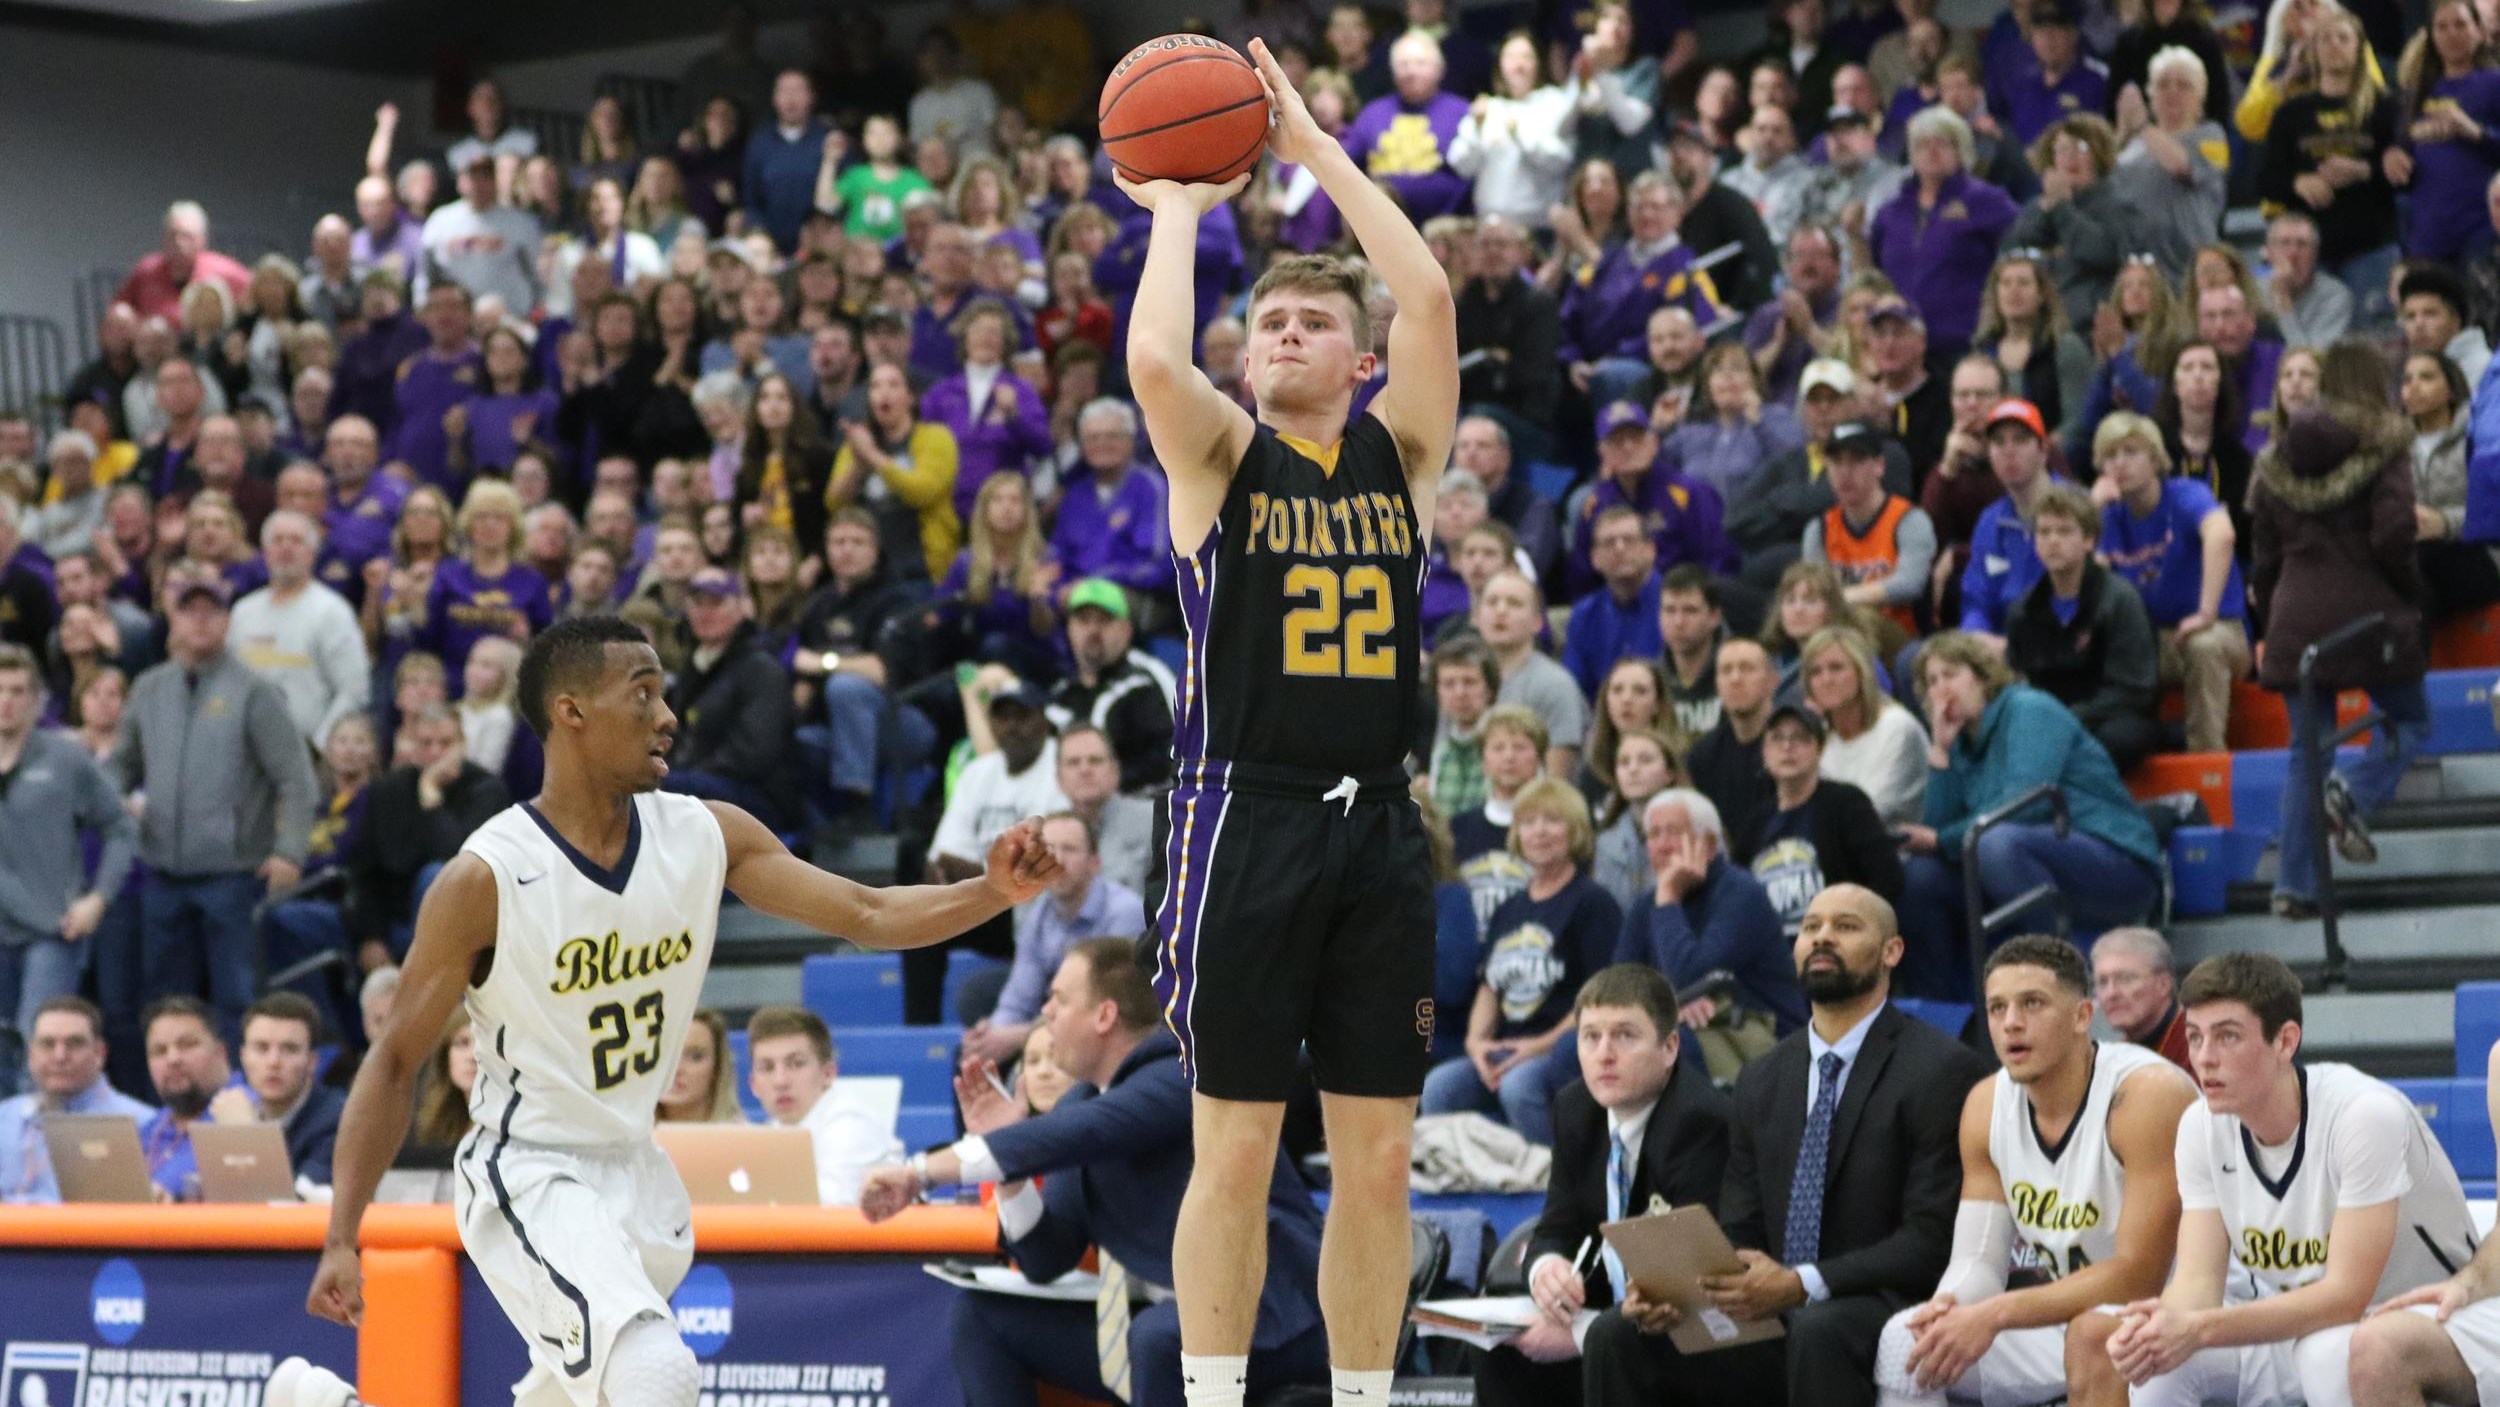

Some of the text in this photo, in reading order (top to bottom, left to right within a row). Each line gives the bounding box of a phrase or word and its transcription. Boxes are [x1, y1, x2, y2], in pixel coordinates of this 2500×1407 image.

[1246, 491, 1412, 560] POINTERS
[1283, 563, 1397, 680] 22
[550, 928, 695, 994] Blues
[588, 989, 665, 1092] 23
[2011, 1180, 2099, 1231] Blues
[2242, 1226, 2331, 1271] Blue
[94, 1297, 145, 1325] NCAA
[677, 1306, 733, 1335] NCAA
[129, 1350, 199, 1376] DIVISION
[200, 1352, 224, 1377] III
[225, 1353, 273, 1379] MEN'S
[718, 1364, 801, 1390] DIVISION
[801, 1365, 830, 1391] III
[830, 1366, 886, 1392] MEN'S
